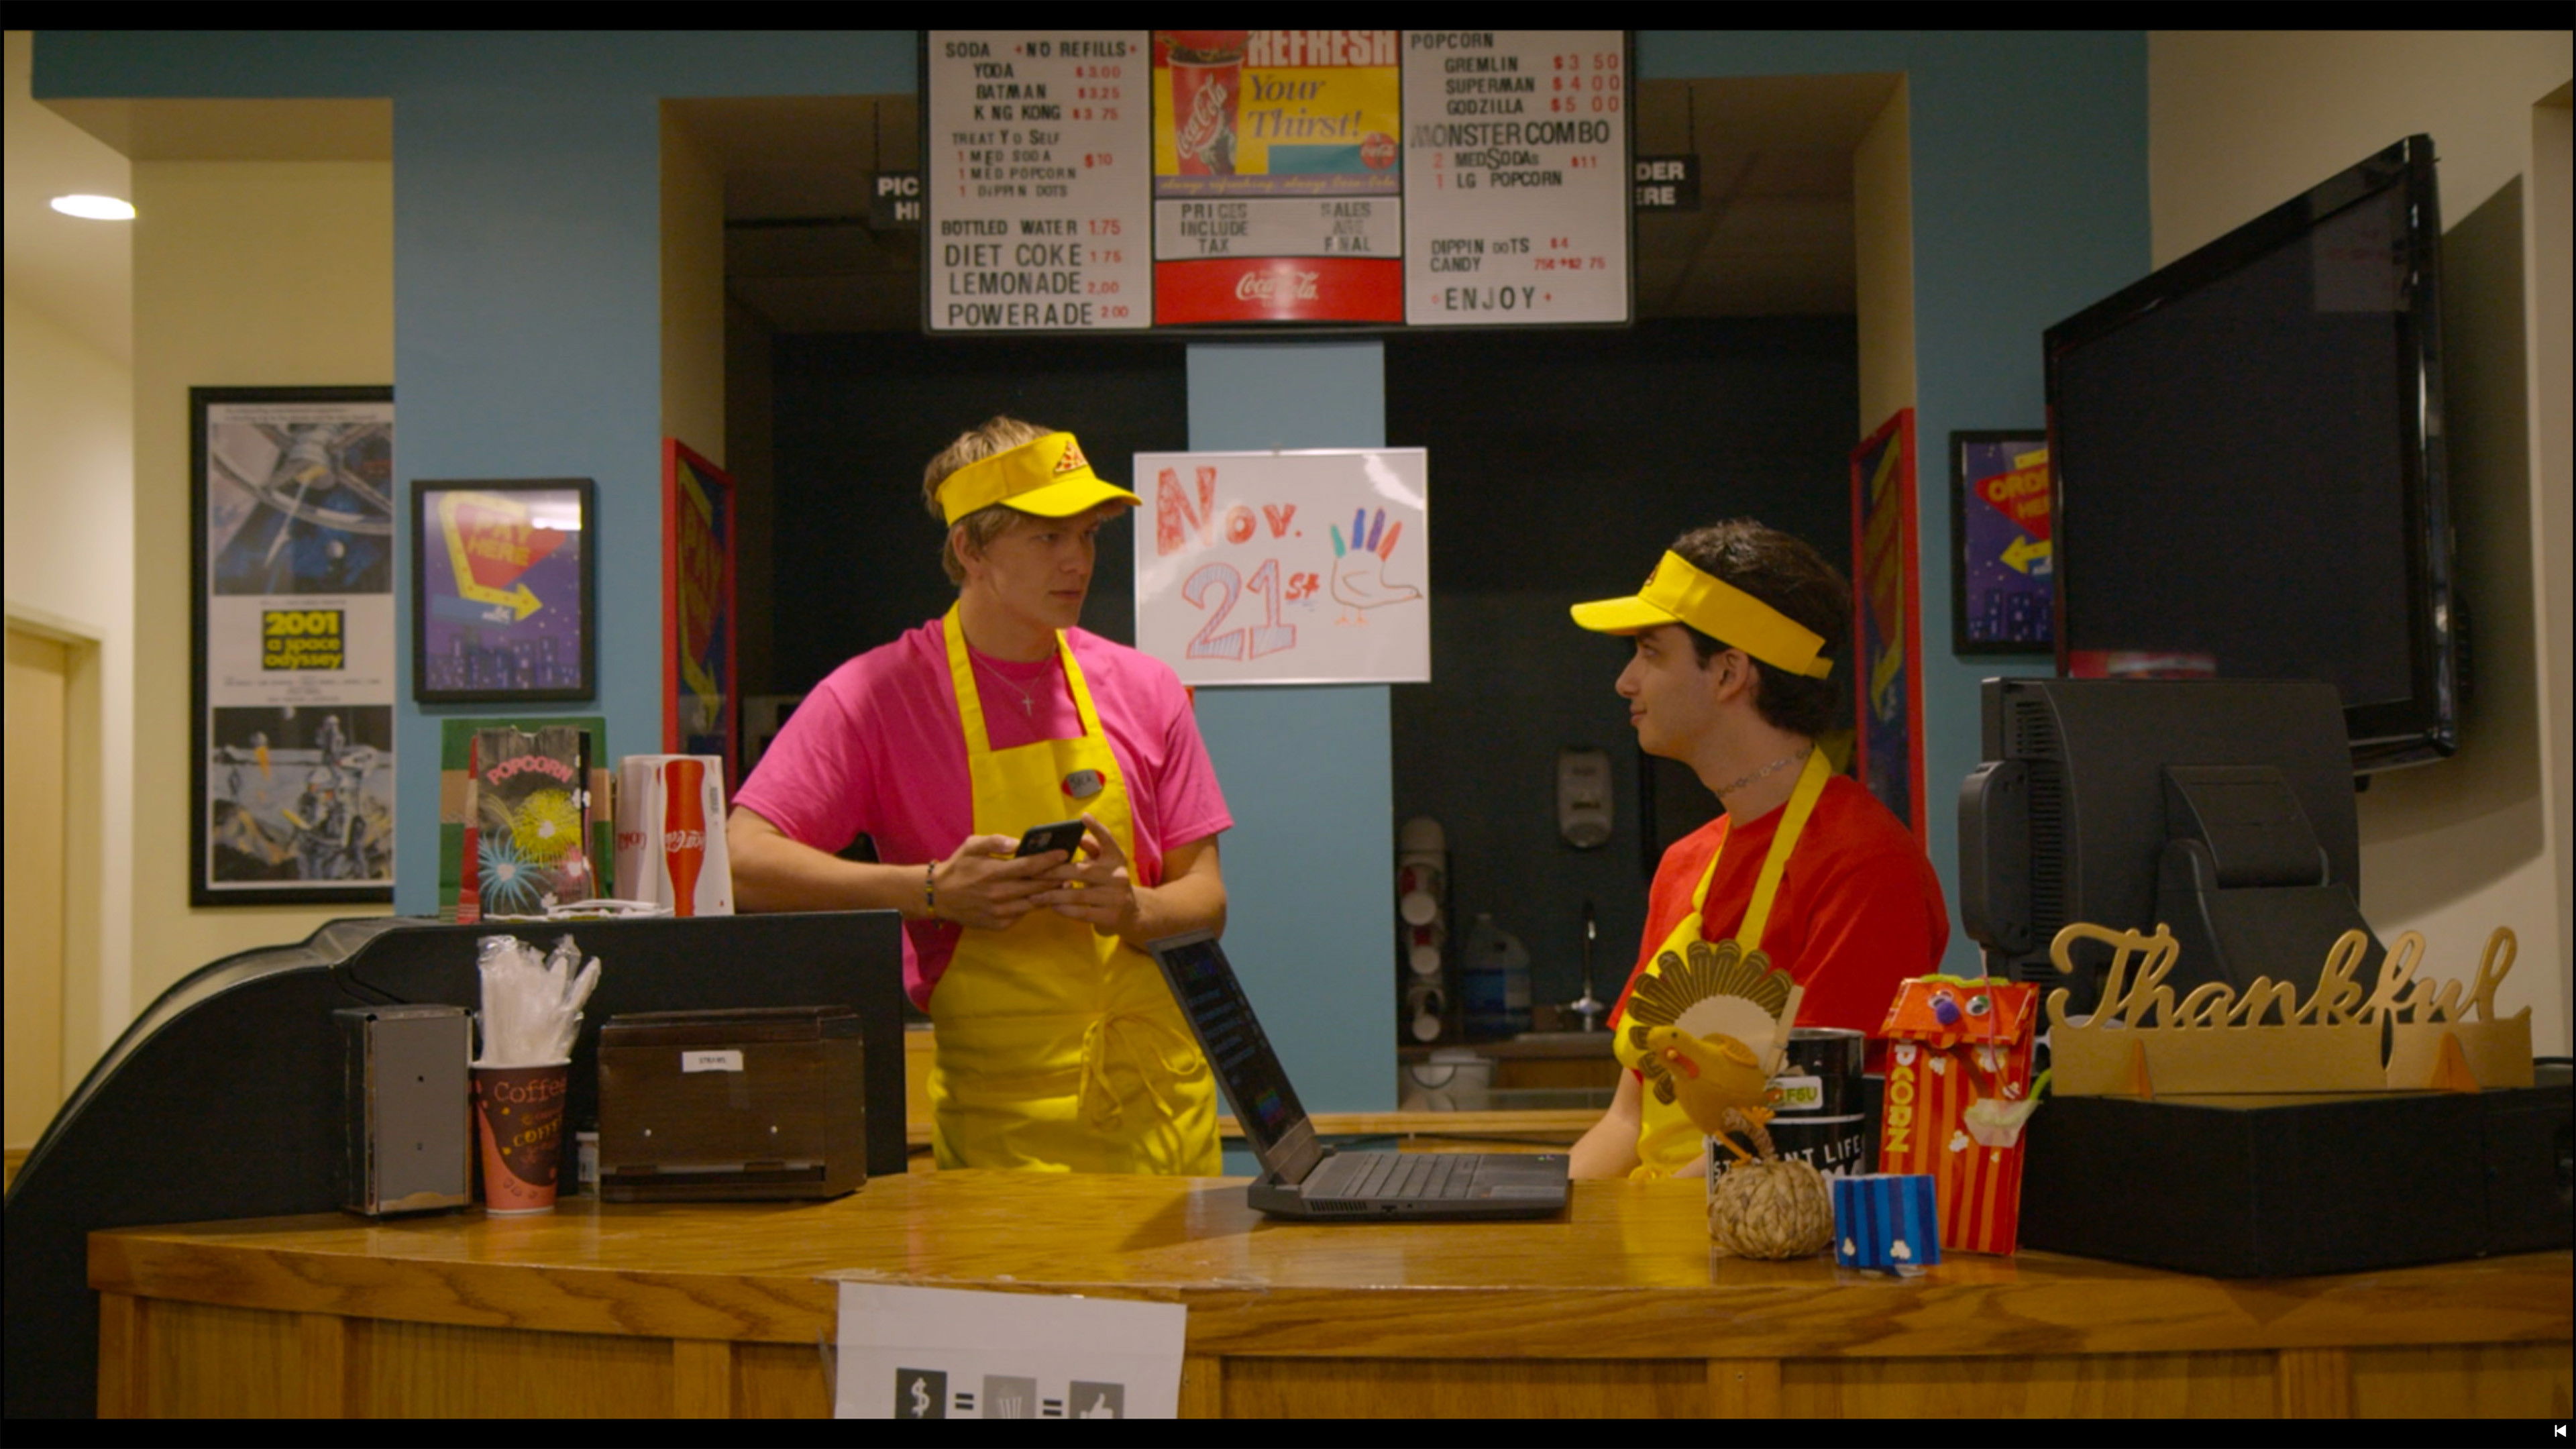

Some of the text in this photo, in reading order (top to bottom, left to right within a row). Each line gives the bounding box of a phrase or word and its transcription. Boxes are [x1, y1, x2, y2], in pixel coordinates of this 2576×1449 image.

[945, 42, 1127, 58] SODA NO REFILLS
[1248, 30, 1395, 66] REFRESH
[1411, 33, 1494, 50] POPCORN
[974, 63, 1014, 78] YODA
[1444, 56, 1519, 74] GREMLIN
[976, 85, 1046, 100] BATMAN
[1249, 74, 1326, 102] Your
[1445, 76, 1535, 95] SUPERMAN
[1022, 105, 1061, 121] KONG
[1446, 98, 1524, 115] GODZILLA
[1248, 107, 1362, 138] Thirst!
[952, 133, 994, 146] TREAT
[1525, 120, 1610, 145] COMBO
[971, 150, 1004, 166] MED
[1012, 150, 1051, 162] SODA
[1433, 153, 1444, 169] 2
[971, 168, 1004, 180] MED
[1010, 168, 1077, 180] POPCORN
[1436, 171, 1562, 189] 1 LG POPCORN
[1181, 203, 1248, 219] PRICES
[942, 220, 1008, 236] BOTTLED
[1021, 219, 1077, 235] WATER
[1181, 221, 1248, 237] INCLUDE
[1198, 238, 1229, 254] TAX
[1324, 236, 1372, 253] FNAL
[1432, 239, 1485, 256] DIPPIN
[945, 244, 1002, 267] DIET
[1016, 244, 1082, 266] COKE
[1430, 256, 1481, 272] CANDY
[949, 272, 1082, 295] LEMONADE
[1445, 286, 1536, 311] ENJOY
[948, 303, 1093, 326] POWERADE
[1157, 466, 1302, 556] Nov.
[264, 611, 339, 636] 2001
[486, 754, 574, 786] POPCORN
[2046, 922, 2532, 1072] Thankful
[1884, 1039, 1917, 1153] PCORN
[1823, 1134, 1860, 1164] LIFE
